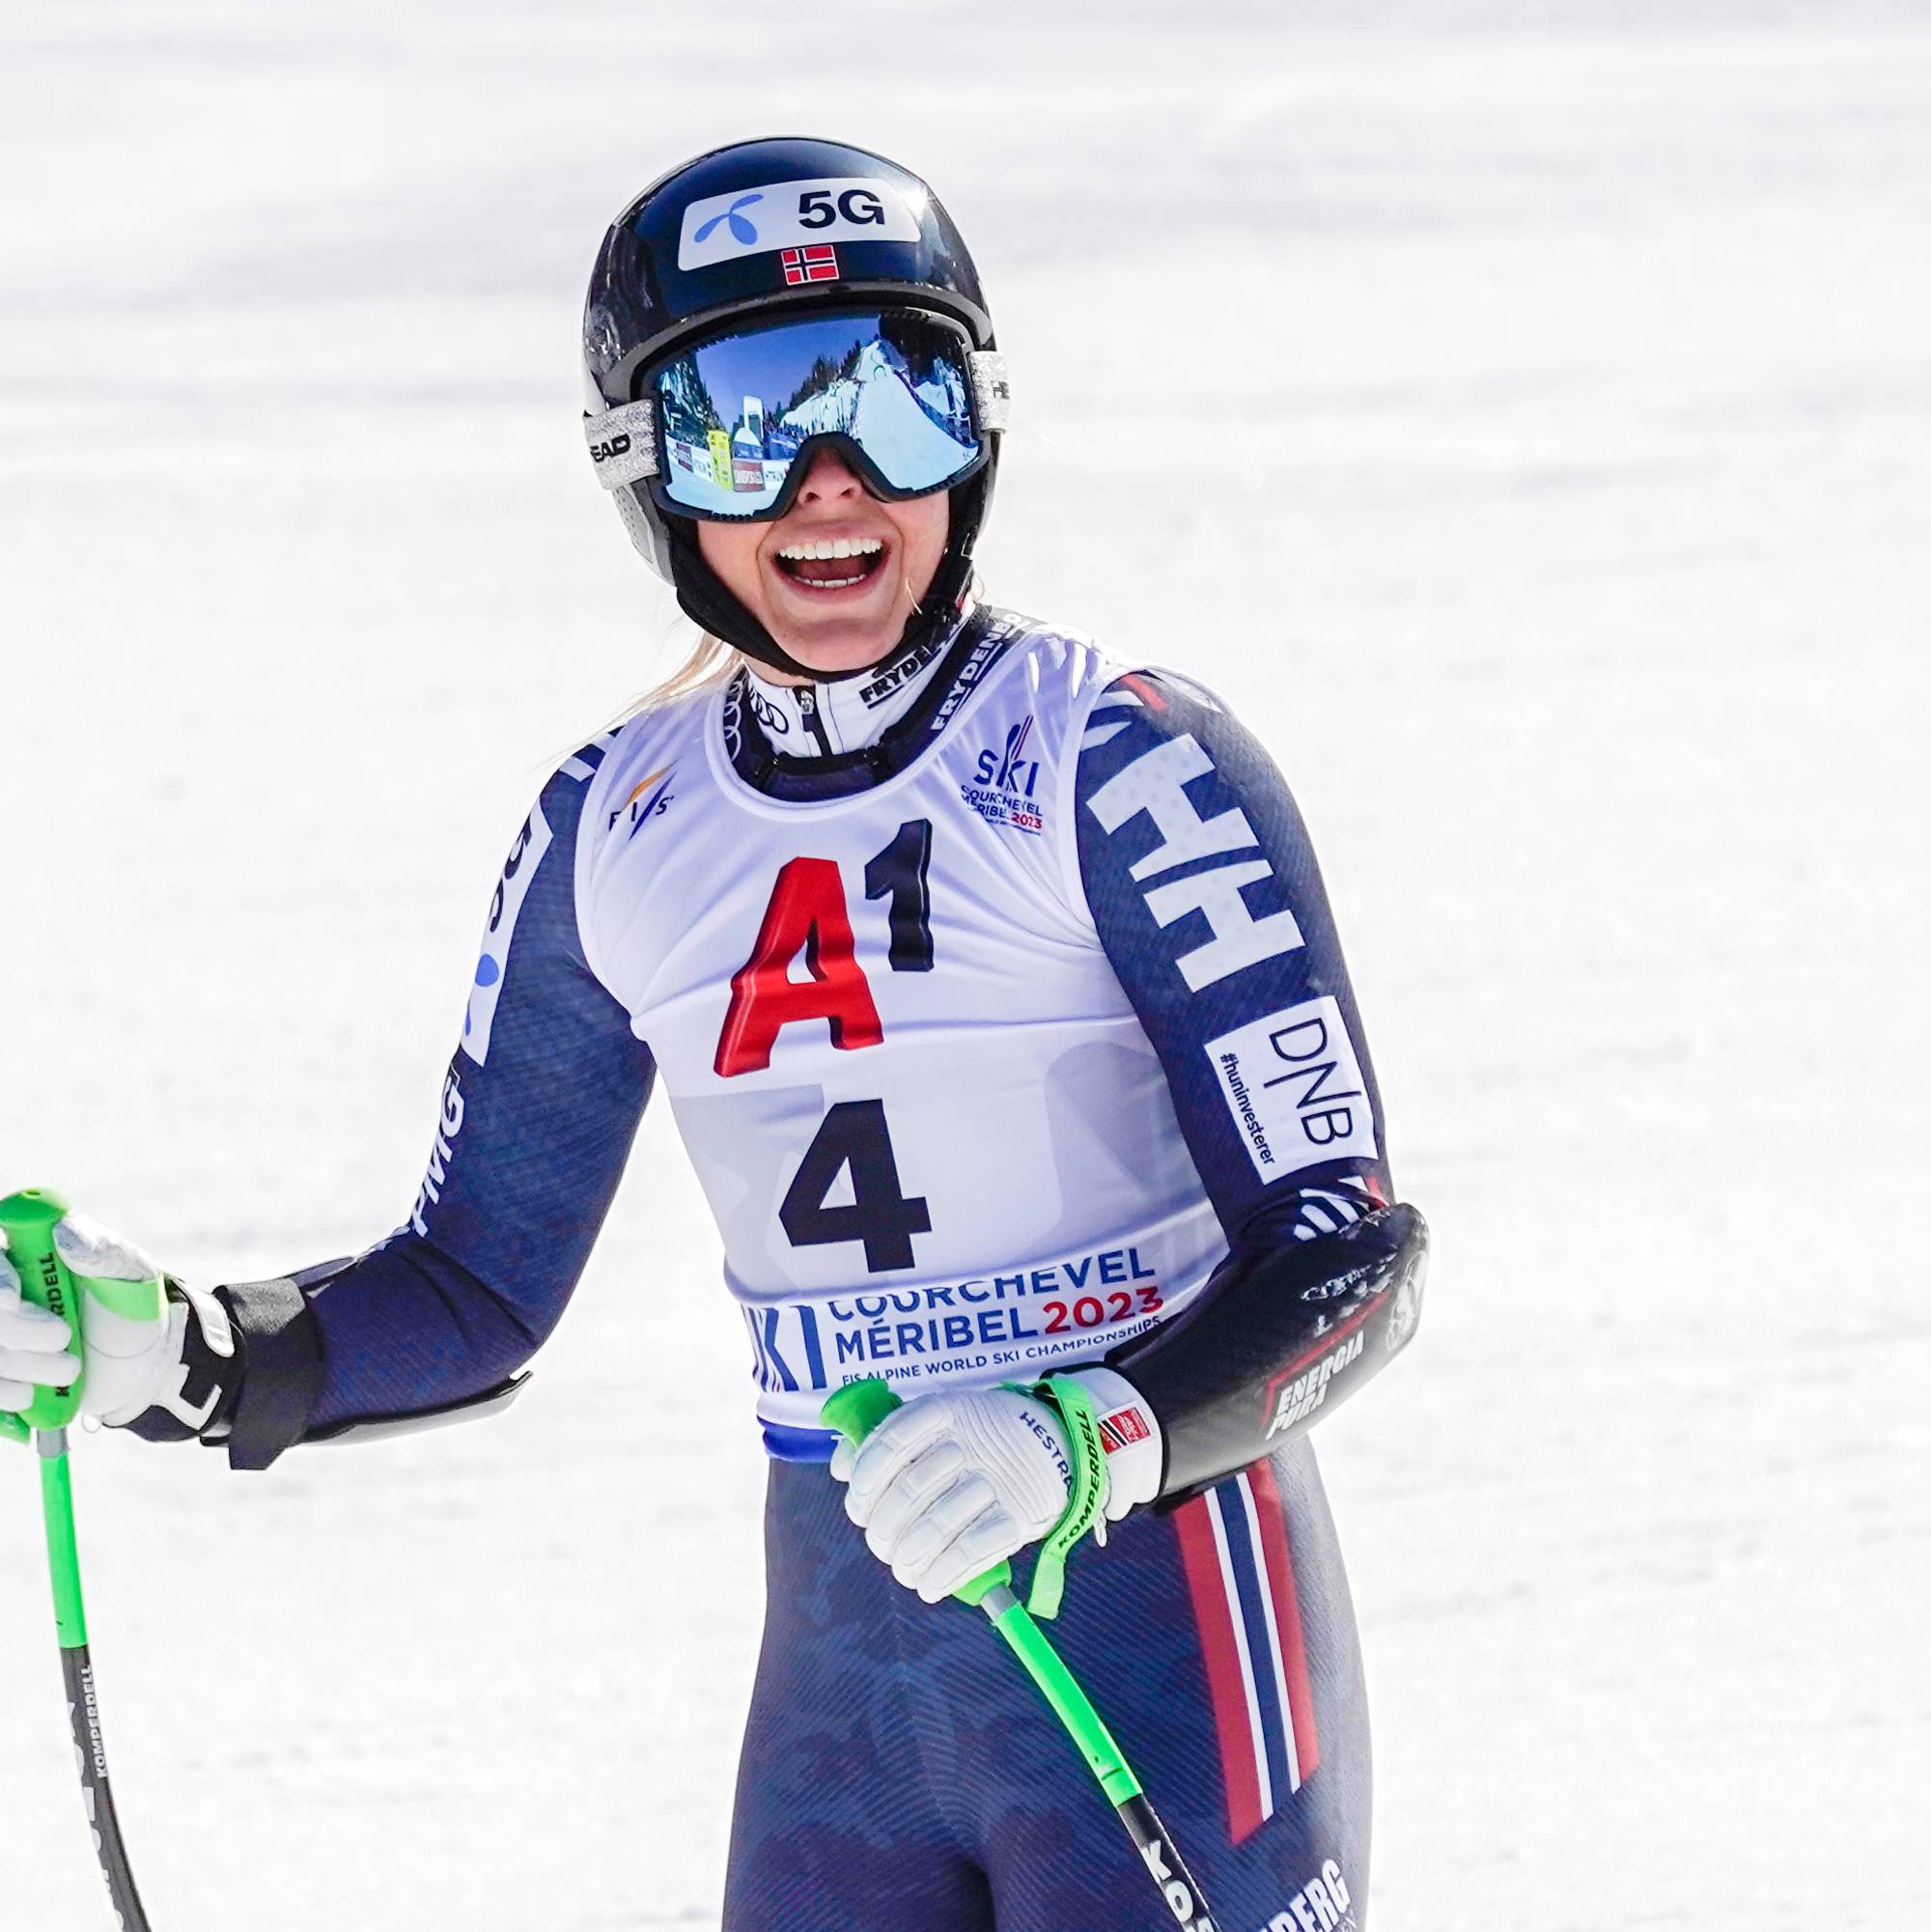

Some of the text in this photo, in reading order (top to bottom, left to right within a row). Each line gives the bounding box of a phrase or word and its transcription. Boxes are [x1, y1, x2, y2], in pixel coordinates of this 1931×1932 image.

[798, 189, 885, 229] 5G
[590, 434, 630, 462] EAD
[973, 724, 1039, 798] SKI
[609, 796, 674, 831] FIS
[714, 818, 935, 1078] A1
[1220, 1052, 1275, 1164] #huninvesterer
[1263, 1017, 1362, 1145] DNB
[779, 1099, 932, 1273] 4
[827, 1247, 1156, 1322] COURCHEVEL
[835, 1286, 1163, 1364] MÉRIBEL 2023
[749, 1304, 827, 1391] KI
[925, 1356, 987, 1375] WORLD
[993, 1352, 1020, 1364] SKI
[1025, 1316, 1161, 1358] CHAMPIONSHIPS
[1058, 1411, 1100, 1550] KOMPERDELL
[81, 1665, 107, 1778] KOMPERDELL
